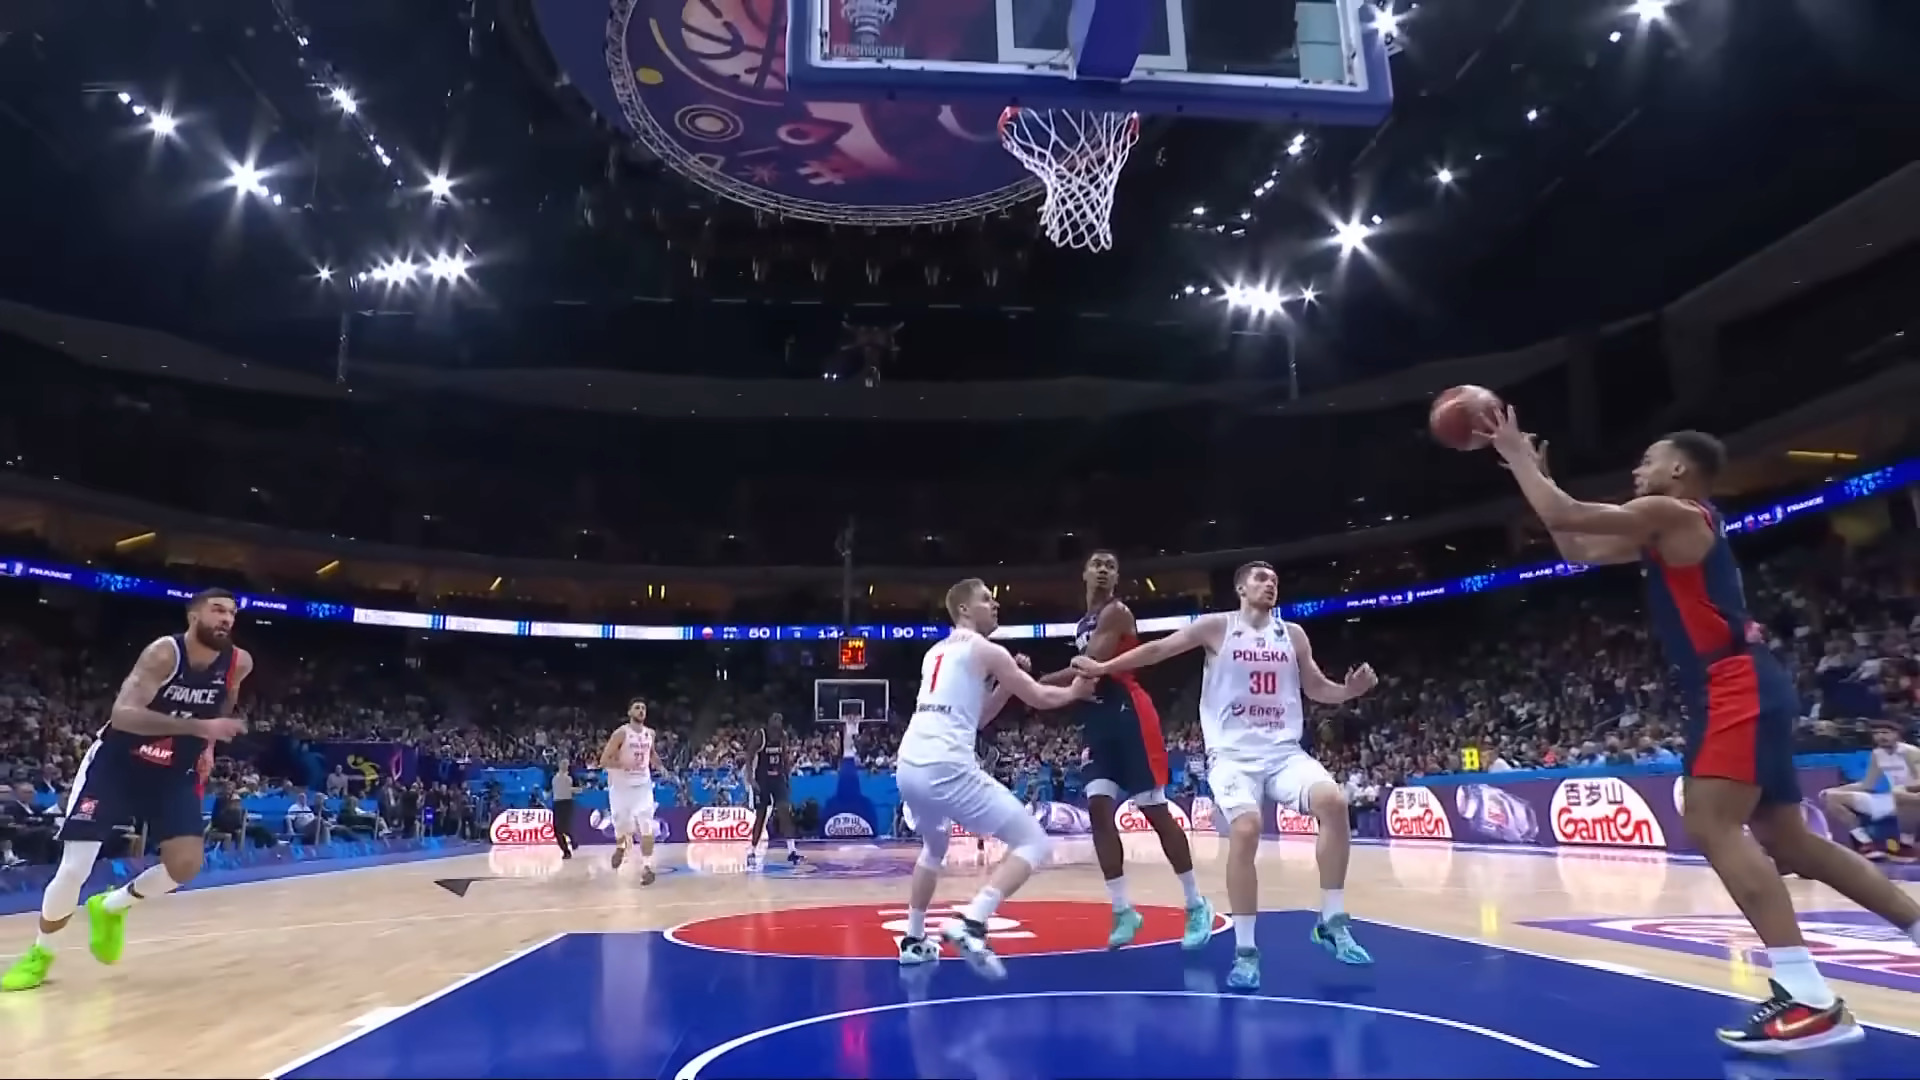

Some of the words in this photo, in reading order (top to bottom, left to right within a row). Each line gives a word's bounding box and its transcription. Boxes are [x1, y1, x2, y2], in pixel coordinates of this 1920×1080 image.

[1233, 649, 1289, 663] POLSKA
[929, 653, 944, 694] 1
[1249, 670, 1277, 695] 30
[163, 685, 218, 705] FRANCE
[1395, 790, 1429, 810] 百岁山
[1564, 782, 1624, 807] 百岁山
[702, 808, 747, 822] 百岁山
[1390, 807, 1446, 836] Ganten
[1558, 806, 1653, 844] Ganten
[495, 823, 555, 842] Gante
[691, 820, 753, 839] Gante
